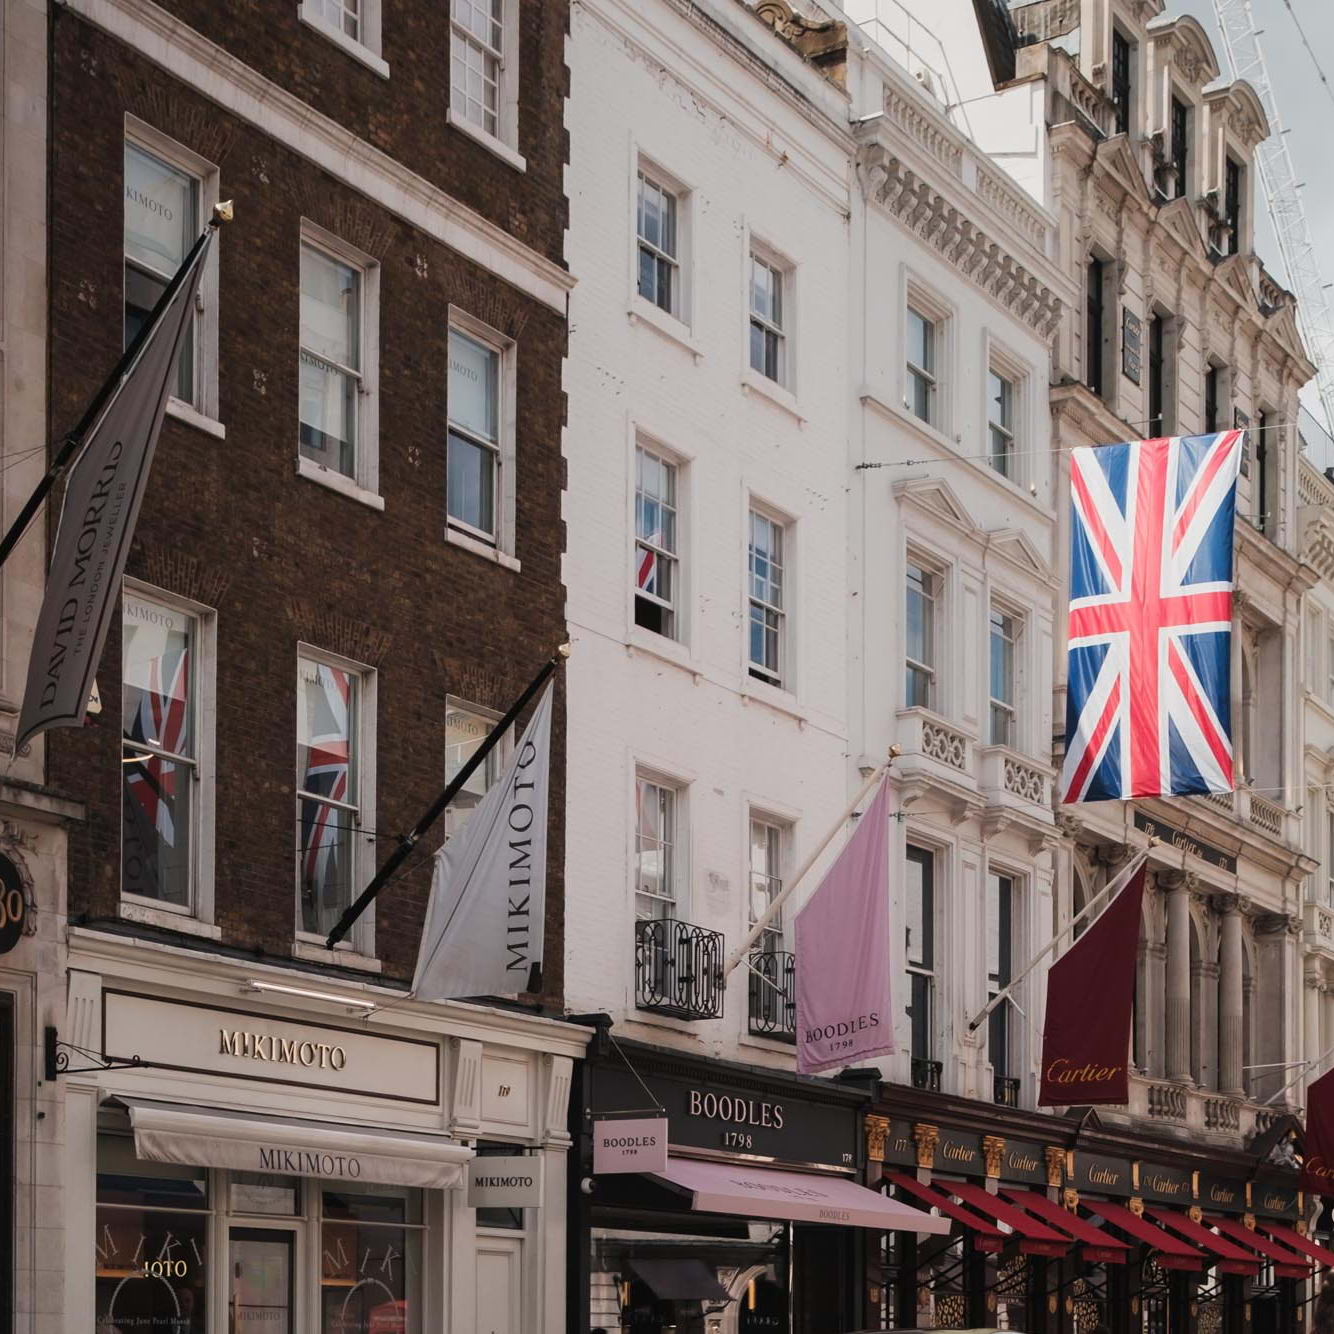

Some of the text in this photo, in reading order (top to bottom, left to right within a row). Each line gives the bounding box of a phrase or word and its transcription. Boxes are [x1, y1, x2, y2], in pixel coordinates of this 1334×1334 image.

[73, 630, 87, 657] THE
[82, 560, 105, 625] LONDON
[39, 599, 79, 711] DAVID
[506, 741, 537, 973] MIKIMOTO
[806, 1012, 880, 1043] BOODLES
[219, 1029, 347, 1072] MIKIMOTO
[830, 1040, 854, 1051] 1798
[1047, 1058, 1123, 1083] Cartier
[690, 1090, 785, 1130] BOODLES
[603, 1136, 657, 1148] BOODLES
[724, 1132, 753, 1149] 1798
[943, 1140, 976, 1163] Cartier
[259, 1148, 361, 1179] MIKIMOTO
[1009, 1150, 1039, 1172] Cartier
[474, 1176, 534, 1188] MIKIMOTO
[1088, 1163, 1120, 1186] Cartier
[1152, 1174, 1180, 1195] Cartier
[1210, 1184, 1236, 1204] Cartier
[1264, 1193, 1288, 1212] Cartier
[818, 1209, 850, 1221] BOODLES
